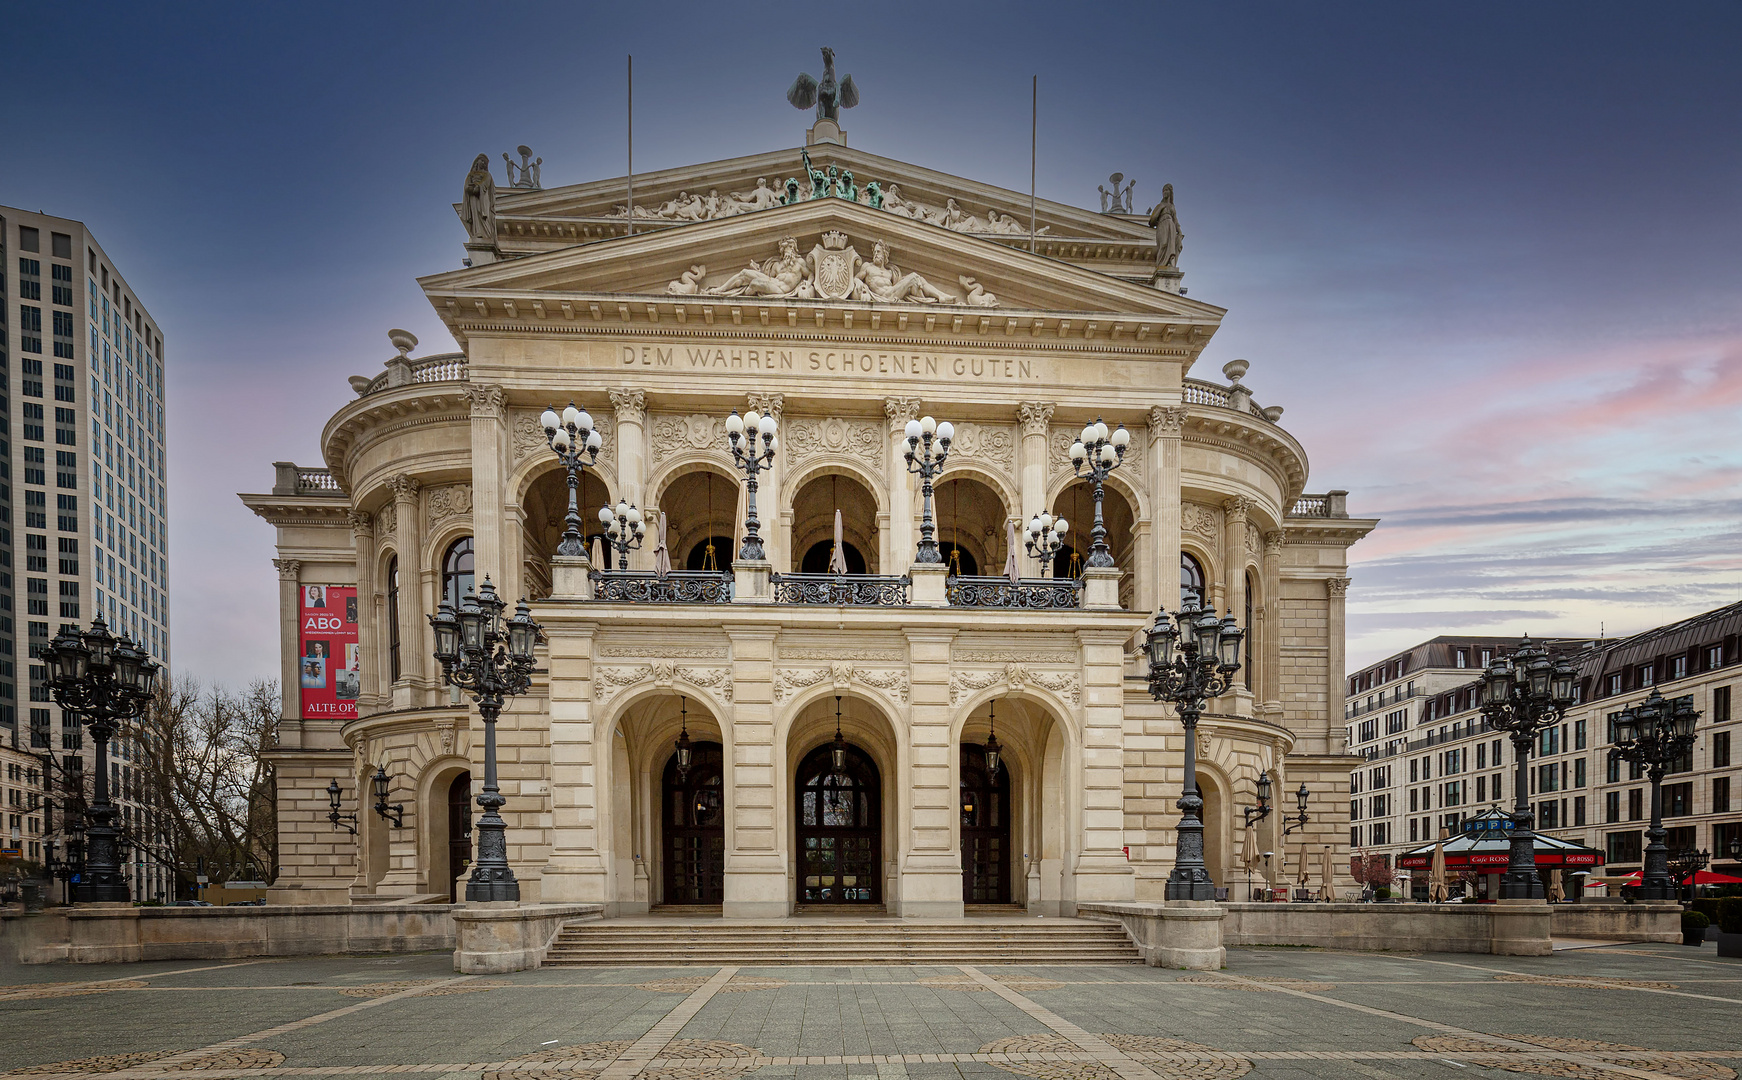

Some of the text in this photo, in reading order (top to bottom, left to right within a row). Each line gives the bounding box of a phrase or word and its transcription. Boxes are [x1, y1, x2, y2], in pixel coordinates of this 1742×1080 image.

[622, 346, 1040, 379] DEM WAHREN SCHOENEN GUTEN.
[304, 617, 342, 630] ABO
[307, 703, 337, 712] ALTE
[1490, 822, 1498, 830] P
[1505, 821, 1512, 829] P
